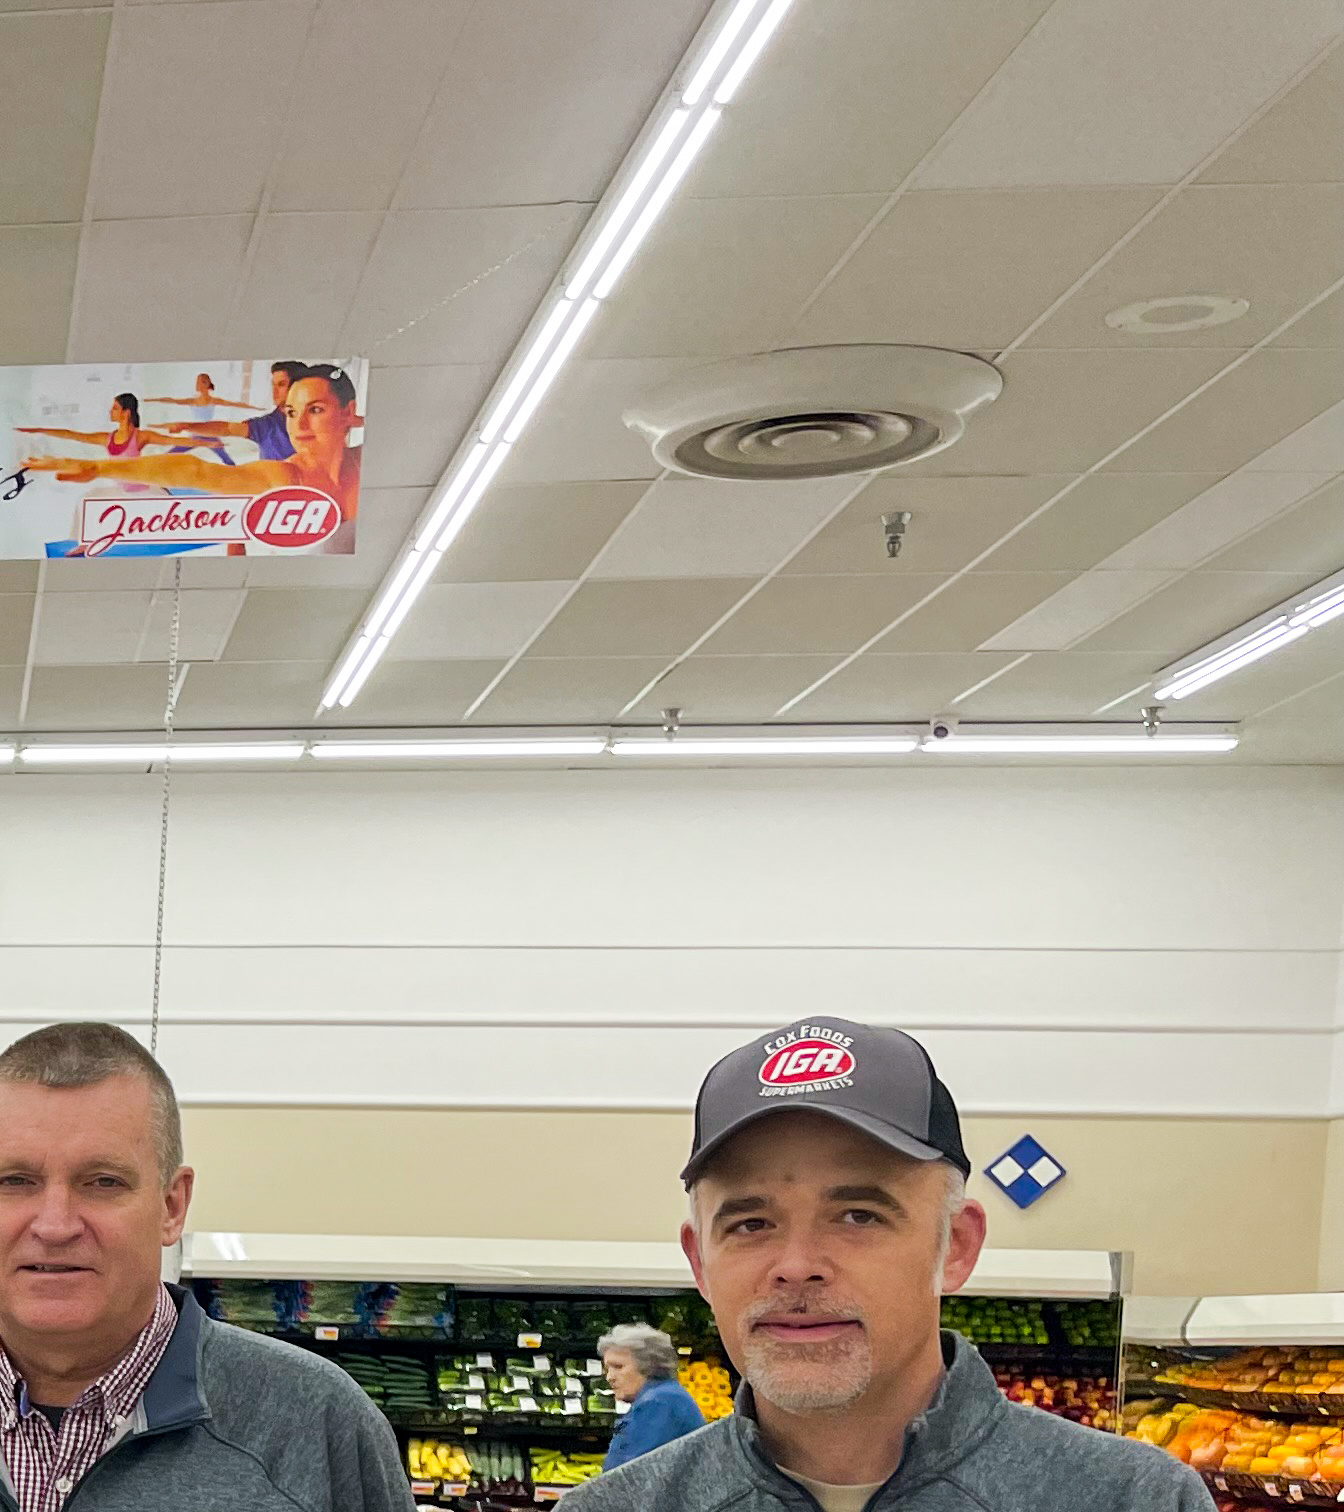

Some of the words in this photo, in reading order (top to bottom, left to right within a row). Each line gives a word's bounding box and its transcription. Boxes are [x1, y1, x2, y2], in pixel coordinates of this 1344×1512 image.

[87, 501, 237, 557] Jackson
[254, 499, 332, 535] IGA
[769, 1047, 845, 1081] IGA
[758, 1077, 855, 1097] SUPERMARKETS
